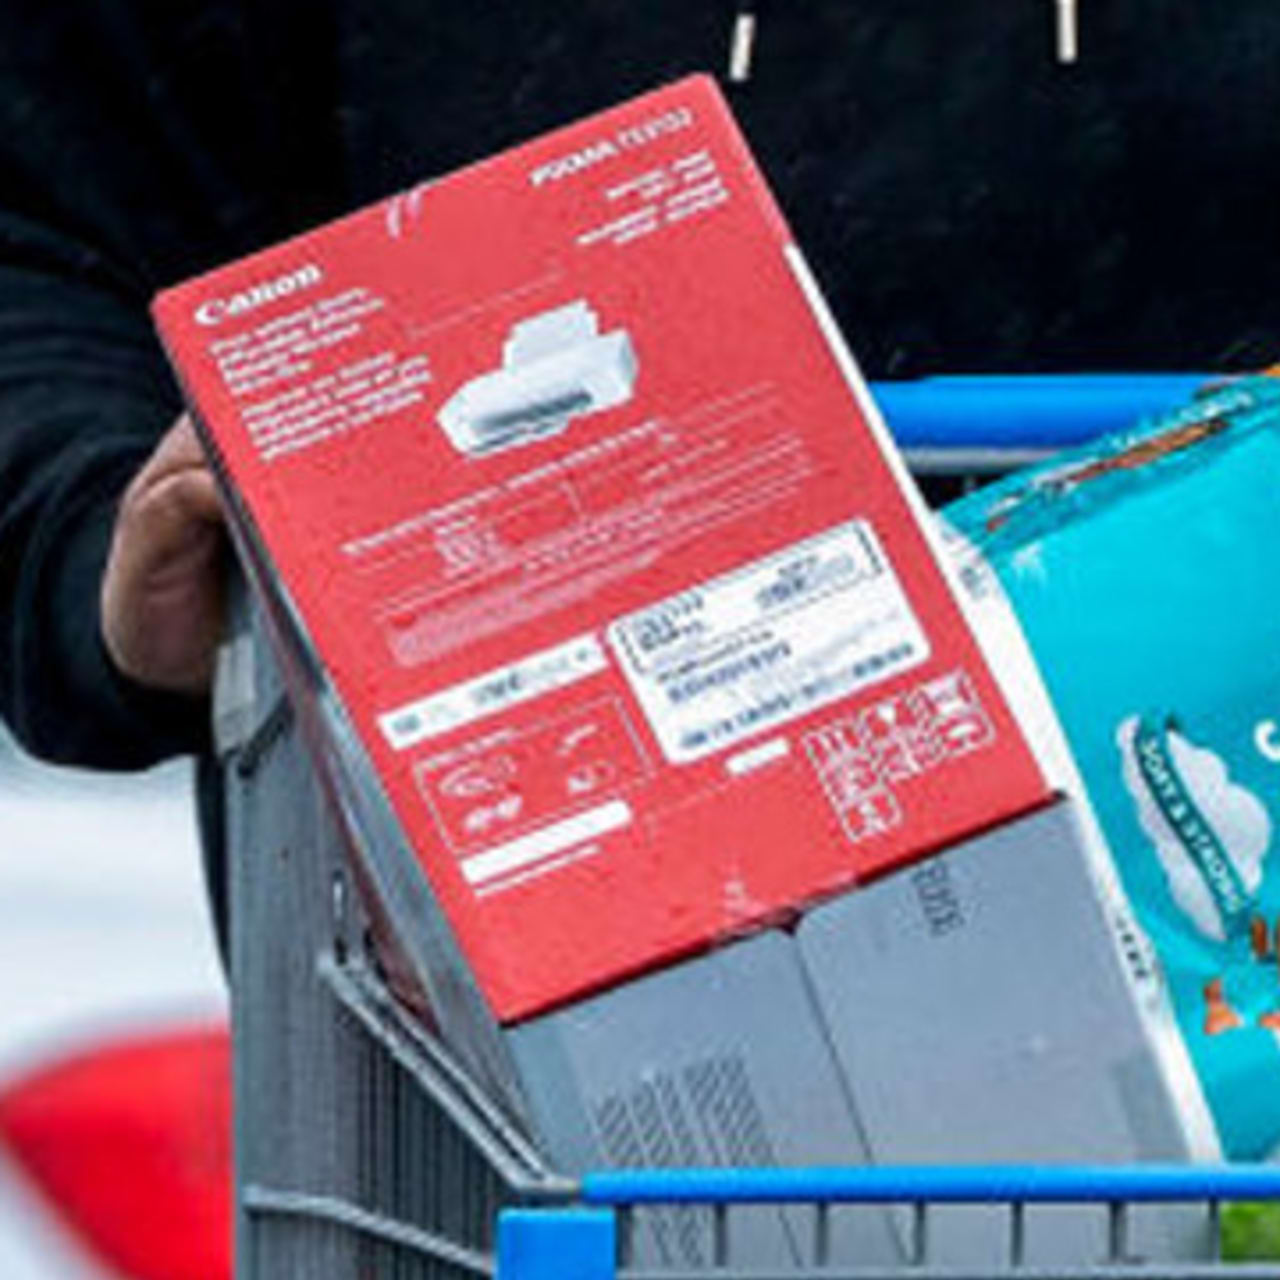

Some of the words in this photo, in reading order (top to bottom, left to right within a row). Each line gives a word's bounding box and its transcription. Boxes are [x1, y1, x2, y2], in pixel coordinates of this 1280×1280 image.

[194, 263, 322, 325] Canon
[1140, 736, 1178, 797] SOFT
[1181, 818, 1245, 915] STRONG
